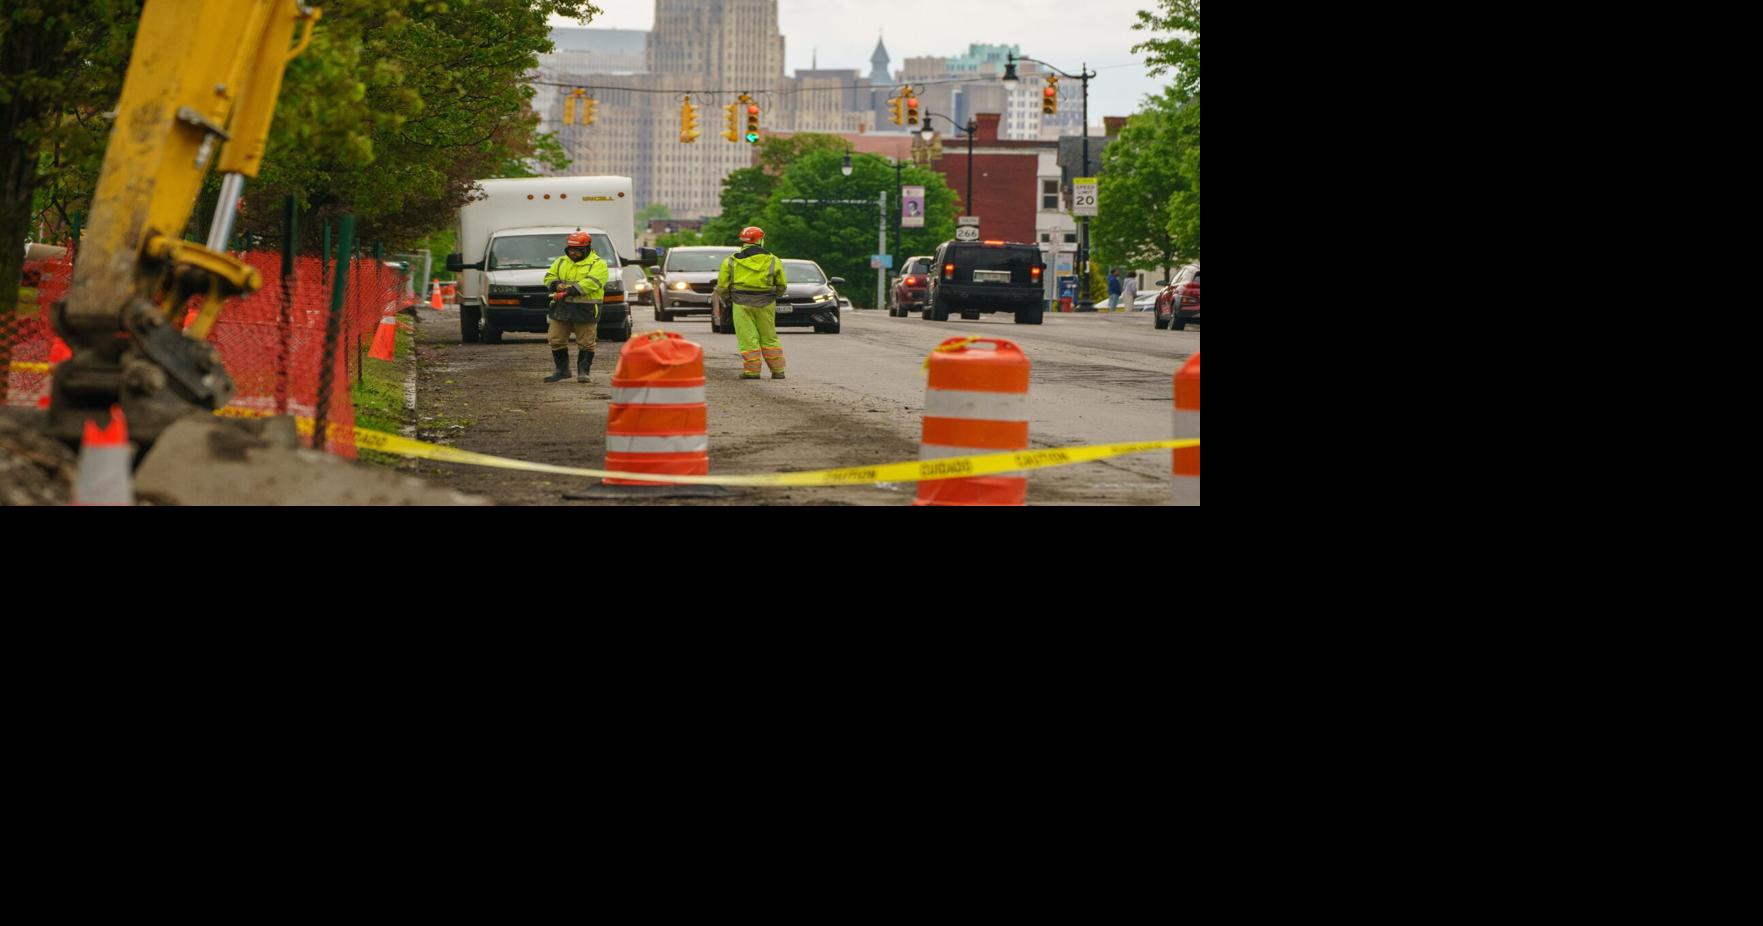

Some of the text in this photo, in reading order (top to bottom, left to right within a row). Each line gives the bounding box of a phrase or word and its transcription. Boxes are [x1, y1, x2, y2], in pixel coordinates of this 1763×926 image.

[1076, 195, 1094, 205] 20
[957, 229, 977, 238] 266
[1014, 451, 1070, 468] CAUTION
